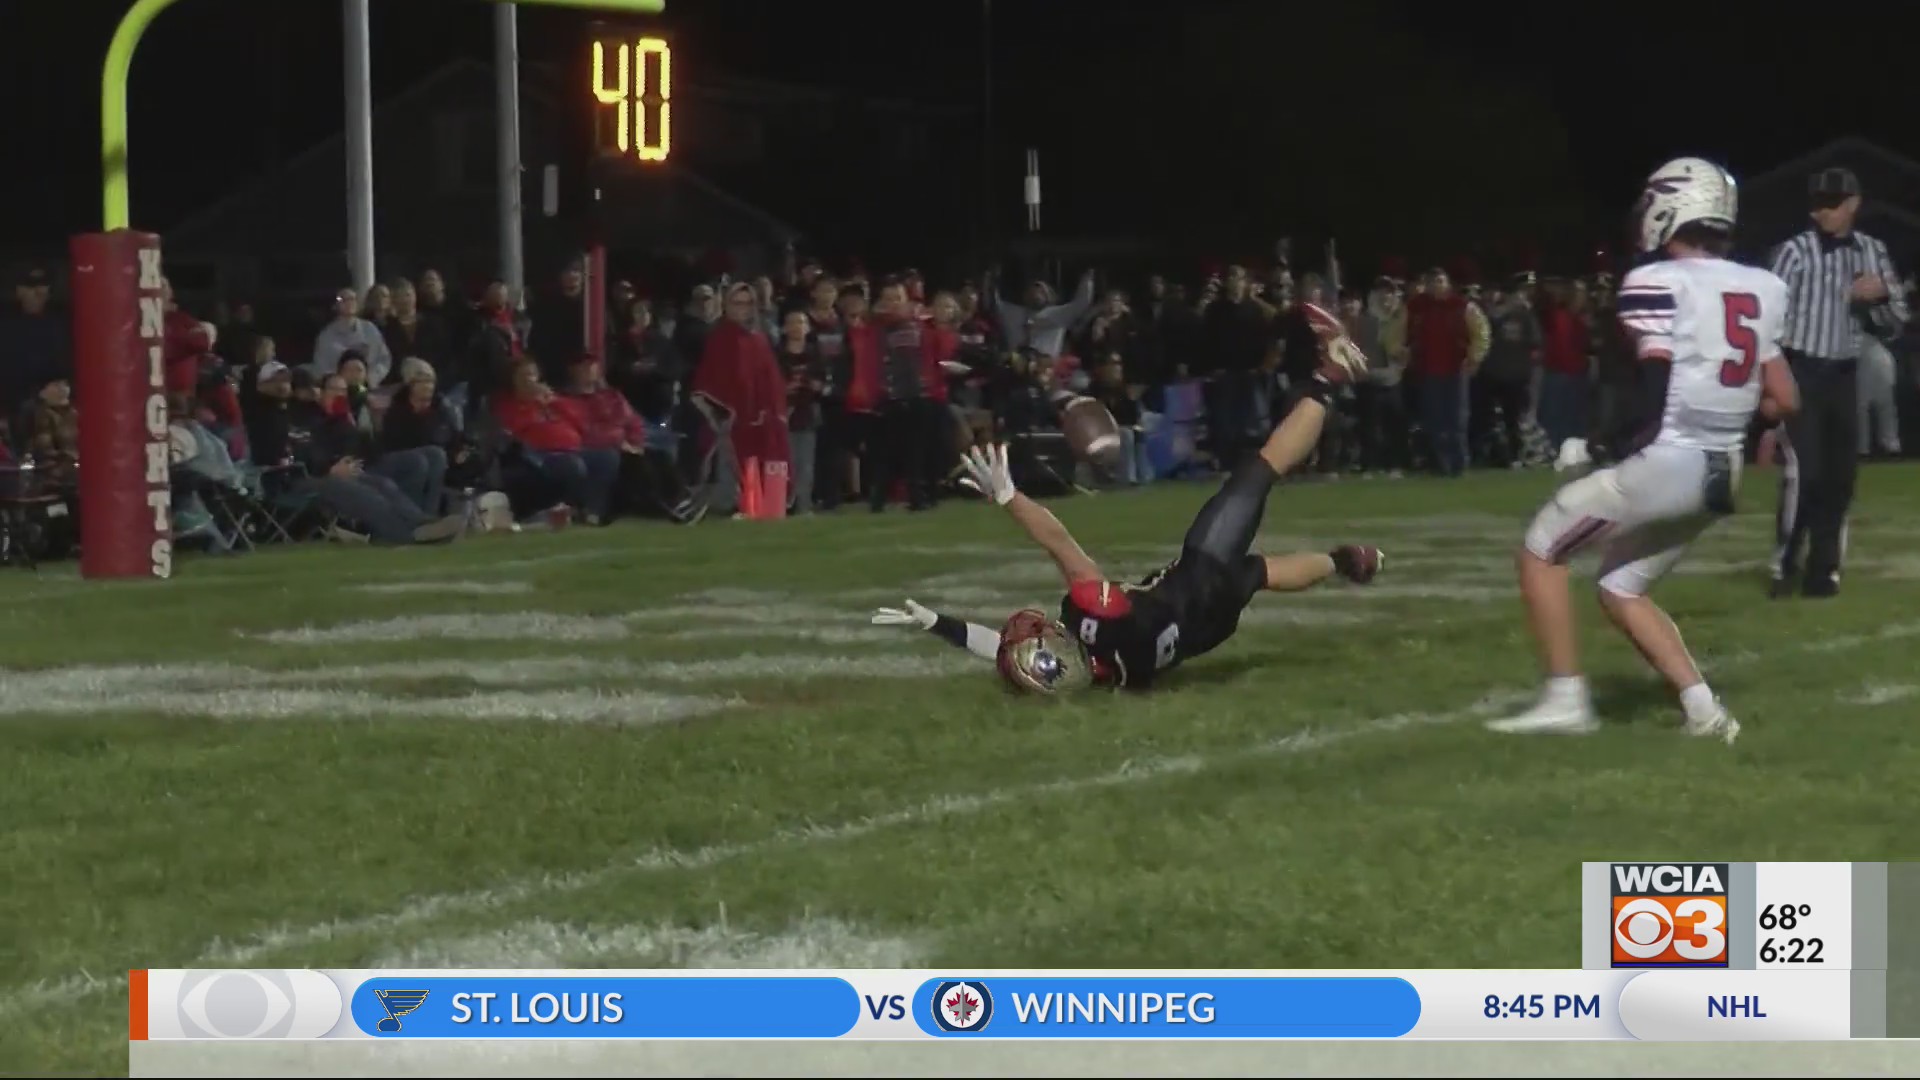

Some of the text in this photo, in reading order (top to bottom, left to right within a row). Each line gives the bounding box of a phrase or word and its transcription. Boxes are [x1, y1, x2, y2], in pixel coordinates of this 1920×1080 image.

[592, 37, 671, 161] 40
[1718, 291, 1762, 388] 5
[137, 248, 172, 579] KNIGHTS
